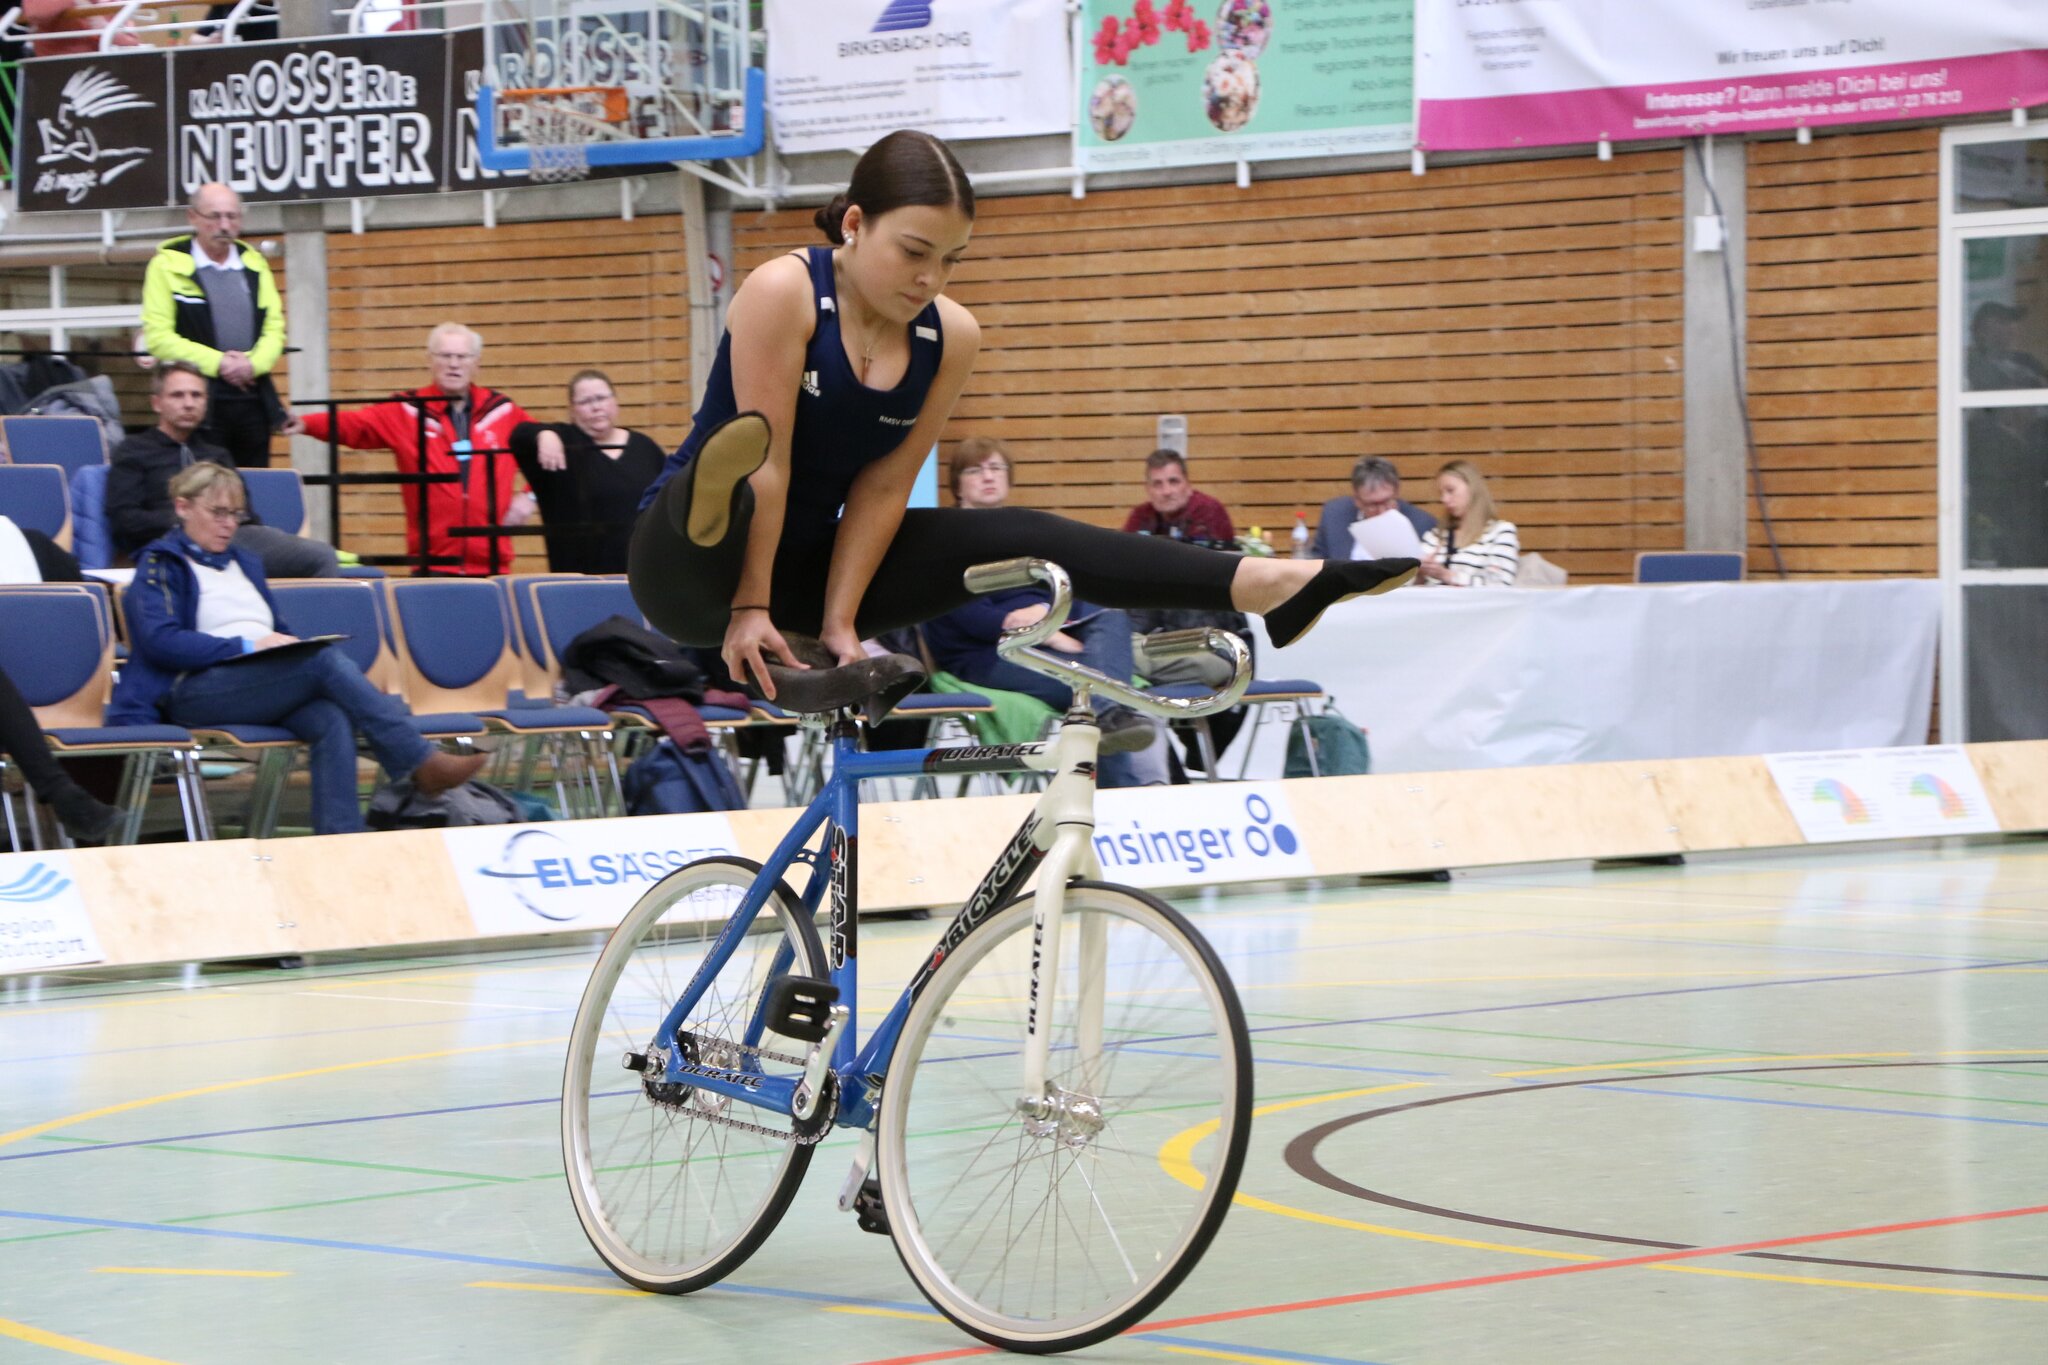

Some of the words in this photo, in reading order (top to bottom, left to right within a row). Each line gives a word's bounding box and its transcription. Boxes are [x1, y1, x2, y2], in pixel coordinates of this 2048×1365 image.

[837, 36, 932, 58] BIRKENBACH
[935, 31, 972, 49] OHG
[1716, 51, 1738, 64] Wir
[1742, 48, 1787, 62] freuen
[1792, 46, 1818, 59] uns
[1823, 42, 1848, 56] auf
[189, 50, 417, 119] KAROSSERIE
[1646, 86, 1737, 110] Interesse?
[1738, 85, 1783, 104] Dann
[1836, 75, 1876, 95] Dich
[1878, 71, 1908, 92] bei
[181, 112, 435, 194] NEUFFER
[942, 743, 1047, 762] DURATEC
[1093, 819, 1236, 873] nsinger
[533, 847, 732, 888] ELSÄSS
[834, 825, 848, 970] STAR
[946, 829, 1036, 949] BICYCLE
[0, 917, 56, 940] egion
[0, 937, 87, 959] tuttgart
[1028, 912, 1045, 1035] DURATEC
[679, 1064, 767, 1089] DURATEC
